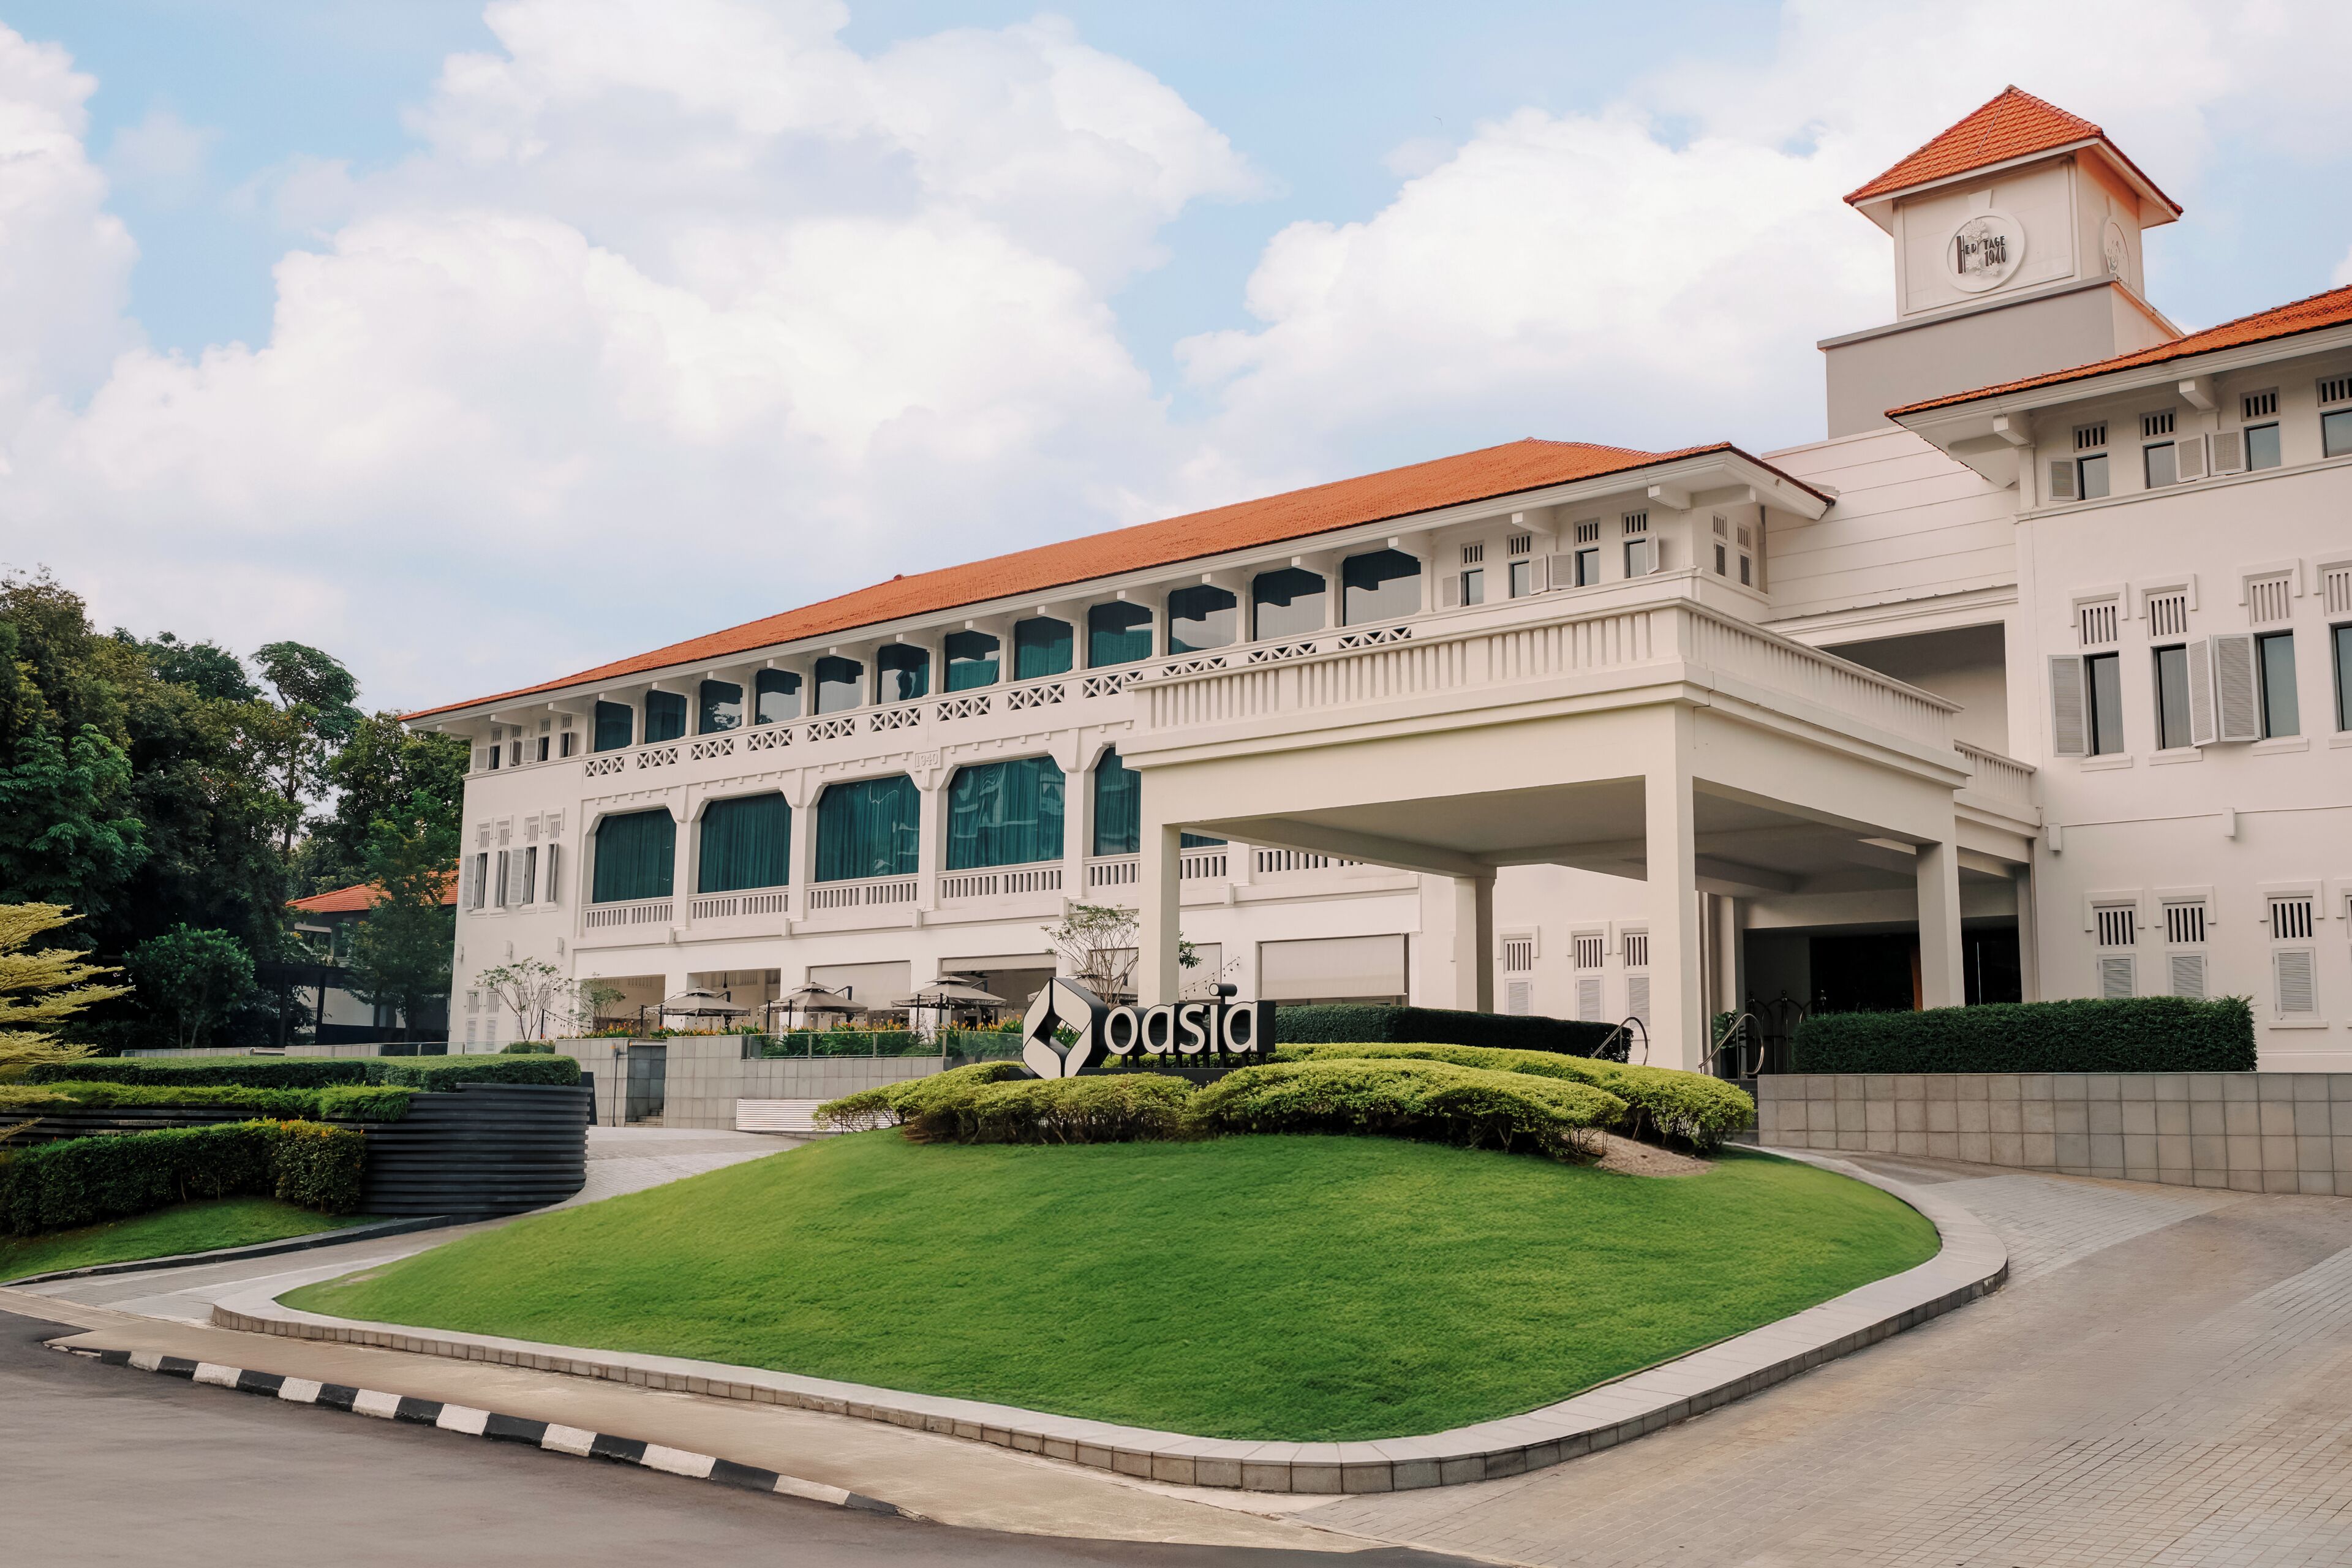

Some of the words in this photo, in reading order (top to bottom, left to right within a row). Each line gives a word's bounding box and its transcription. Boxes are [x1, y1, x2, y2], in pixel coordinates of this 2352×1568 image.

[1985, 246, 2006, 266] 1940
[916, 753, 938, 767] 1940
[1104, 983, 1259, 1055] oasia
